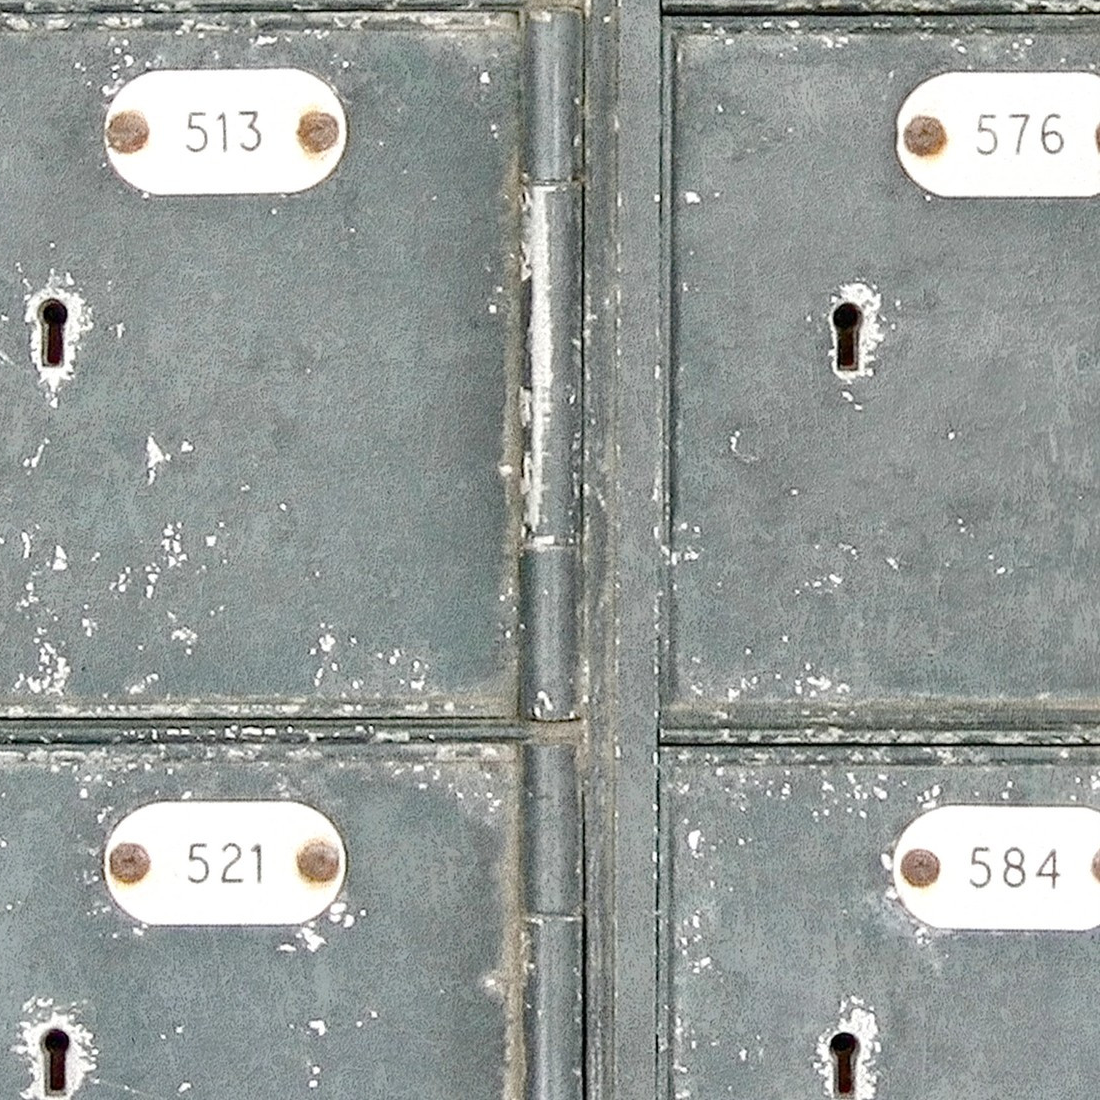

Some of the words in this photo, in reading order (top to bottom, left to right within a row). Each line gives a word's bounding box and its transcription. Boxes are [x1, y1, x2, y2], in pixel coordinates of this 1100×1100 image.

[187, 110, 262, 154] 513
[977, 113, 1065, 156] 576
[187, 841, 263, 885] 521
[970, 846, 1061, 889] 584
